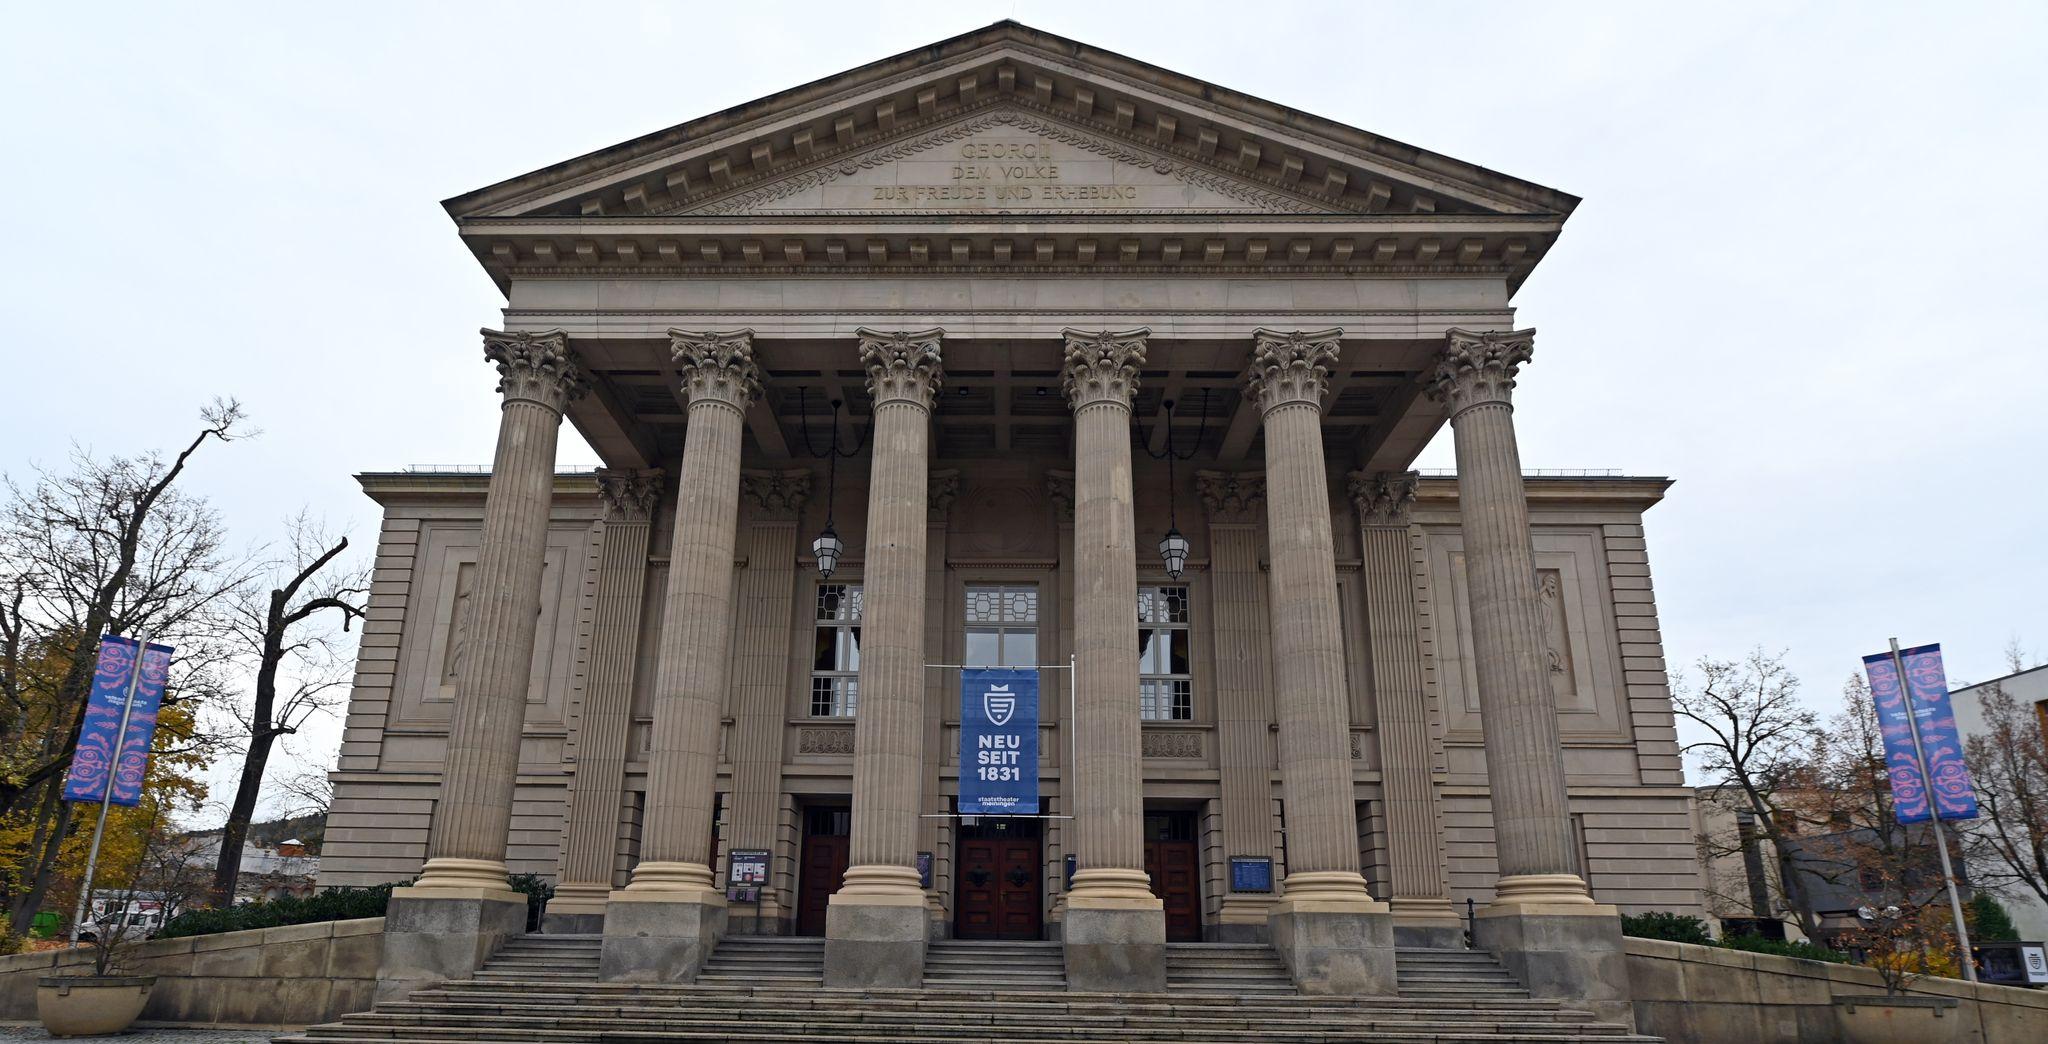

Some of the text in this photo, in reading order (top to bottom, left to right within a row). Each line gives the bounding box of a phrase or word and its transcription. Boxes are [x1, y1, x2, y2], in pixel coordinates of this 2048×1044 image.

[962, 143, 1036, 159] GEORG
[952, 166, 1059, 180] DEM VOLKE
[873, 186, 1137, 201] ZUR FREUDE UND ERHEBUNG
[978, 735, 1020, 749] NEU
[978, 750, 1020, 764] SEIT
[977, 766, 1020, 781] 1831
